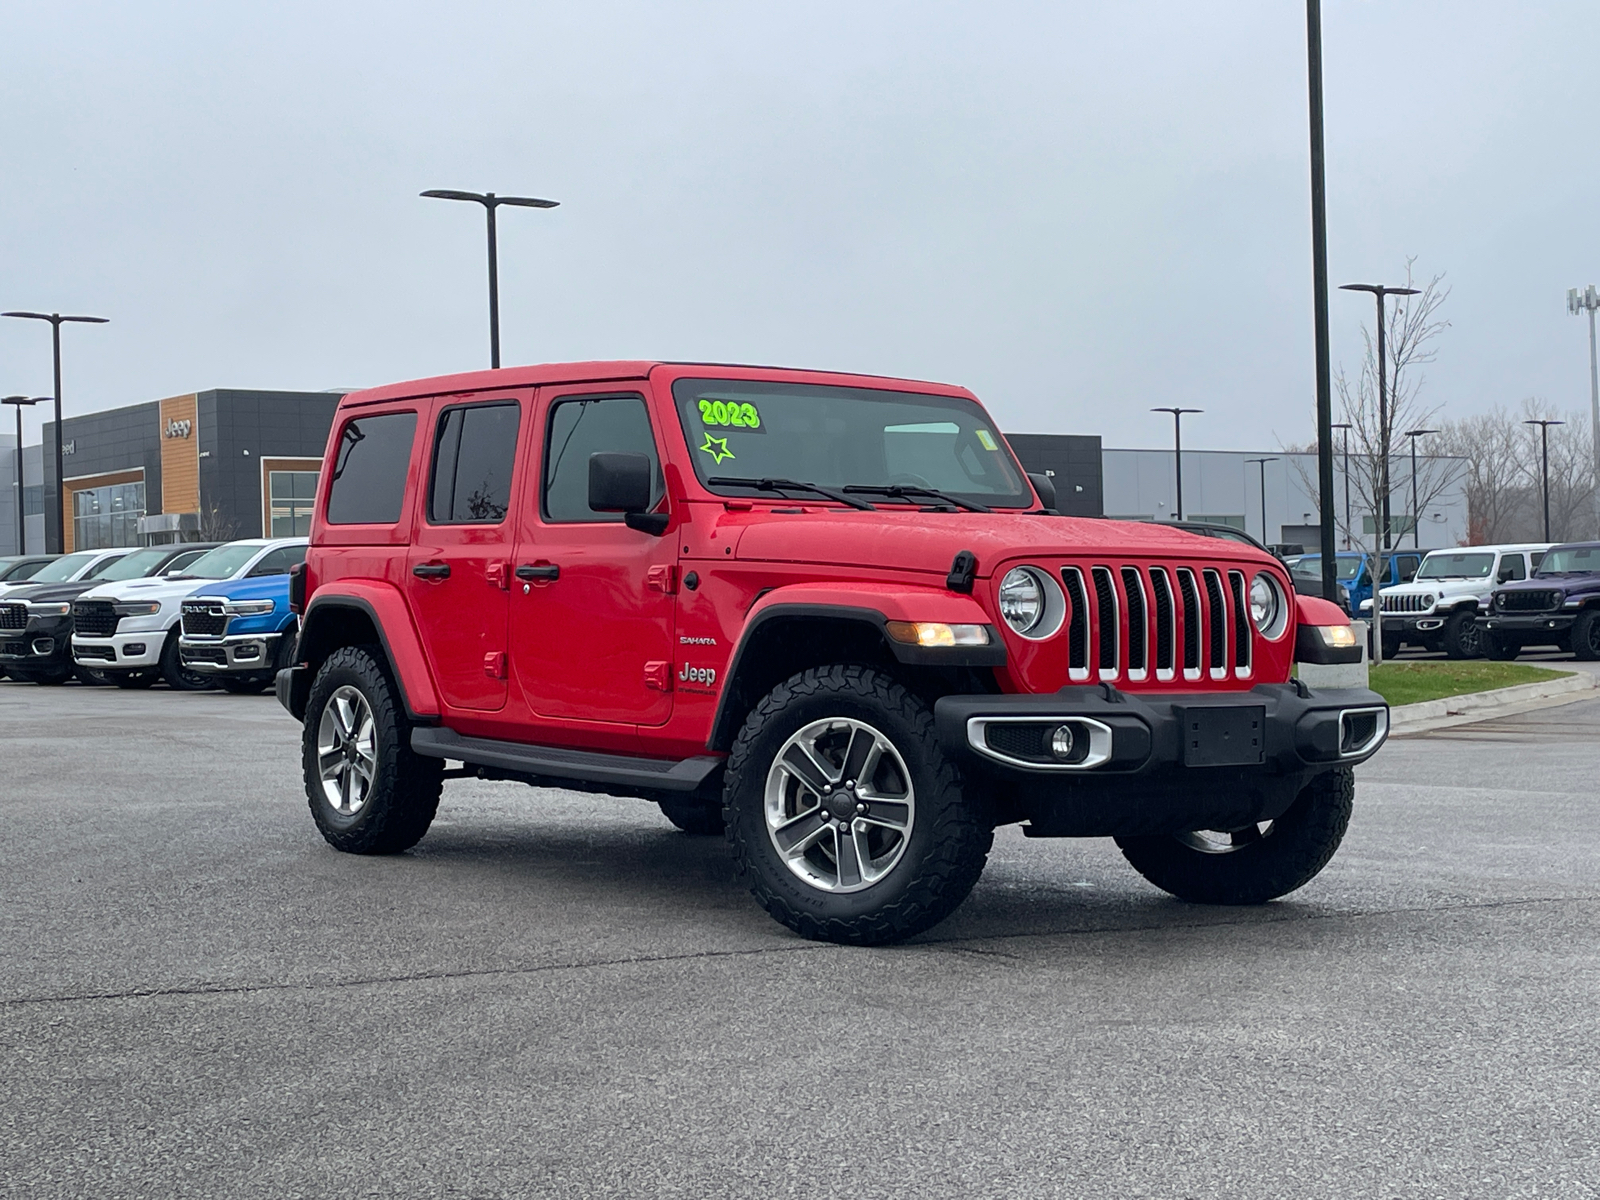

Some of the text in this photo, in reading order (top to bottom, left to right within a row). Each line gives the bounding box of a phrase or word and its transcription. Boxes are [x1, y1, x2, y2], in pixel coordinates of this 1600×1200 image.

[698, 399, 761, 429] 2023
[165, 417, 191, 440] Jeep
[679, 636, 717, 645] SAHARA
[678, 661, 716, 687] Jeep
